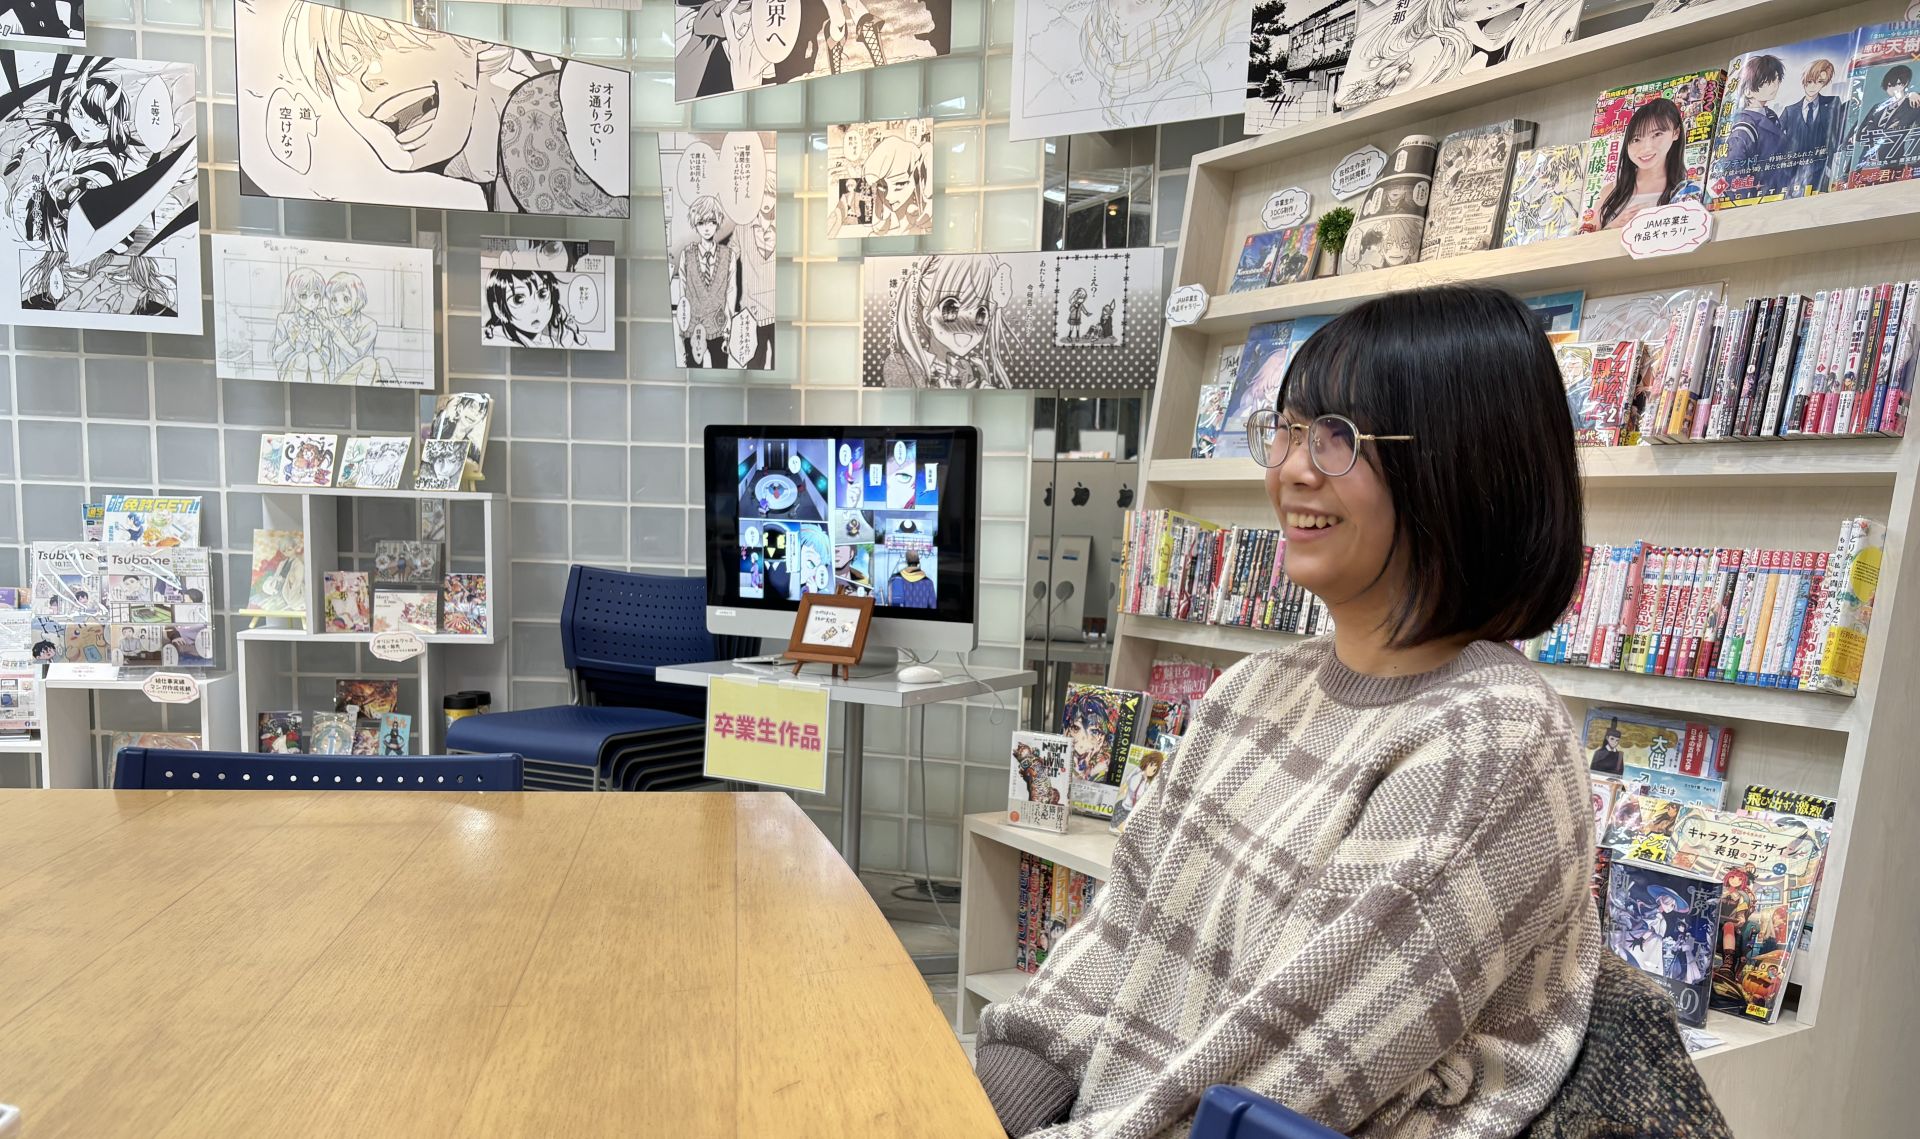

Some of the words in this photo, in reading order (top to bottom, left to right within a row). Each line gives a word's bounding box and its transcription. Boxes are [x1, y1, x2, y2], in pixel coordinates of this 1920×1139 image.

[766, 0, 786, 46] 界へ
[150, 99, 161, 126] 上等だ
[299, 107, 313, 121] 道
[589, 82, 601, 162] お通りでい！
[602, 82, 614, 135] オイラの
[279, 106, 294, 160] 空けなッ
[1634, 226, 1697, 243] 作品ギャラリー
[1643, 214, 1690, 230] JAM卒業生
[714, 712, 821, 752] 卒業生作品
[1118, 713, 1135, 763] VISIONS
[1687, 827, 1804, 858] キャラクターデザインと
[1714, 845, 1769, 863] 表現のコツ
